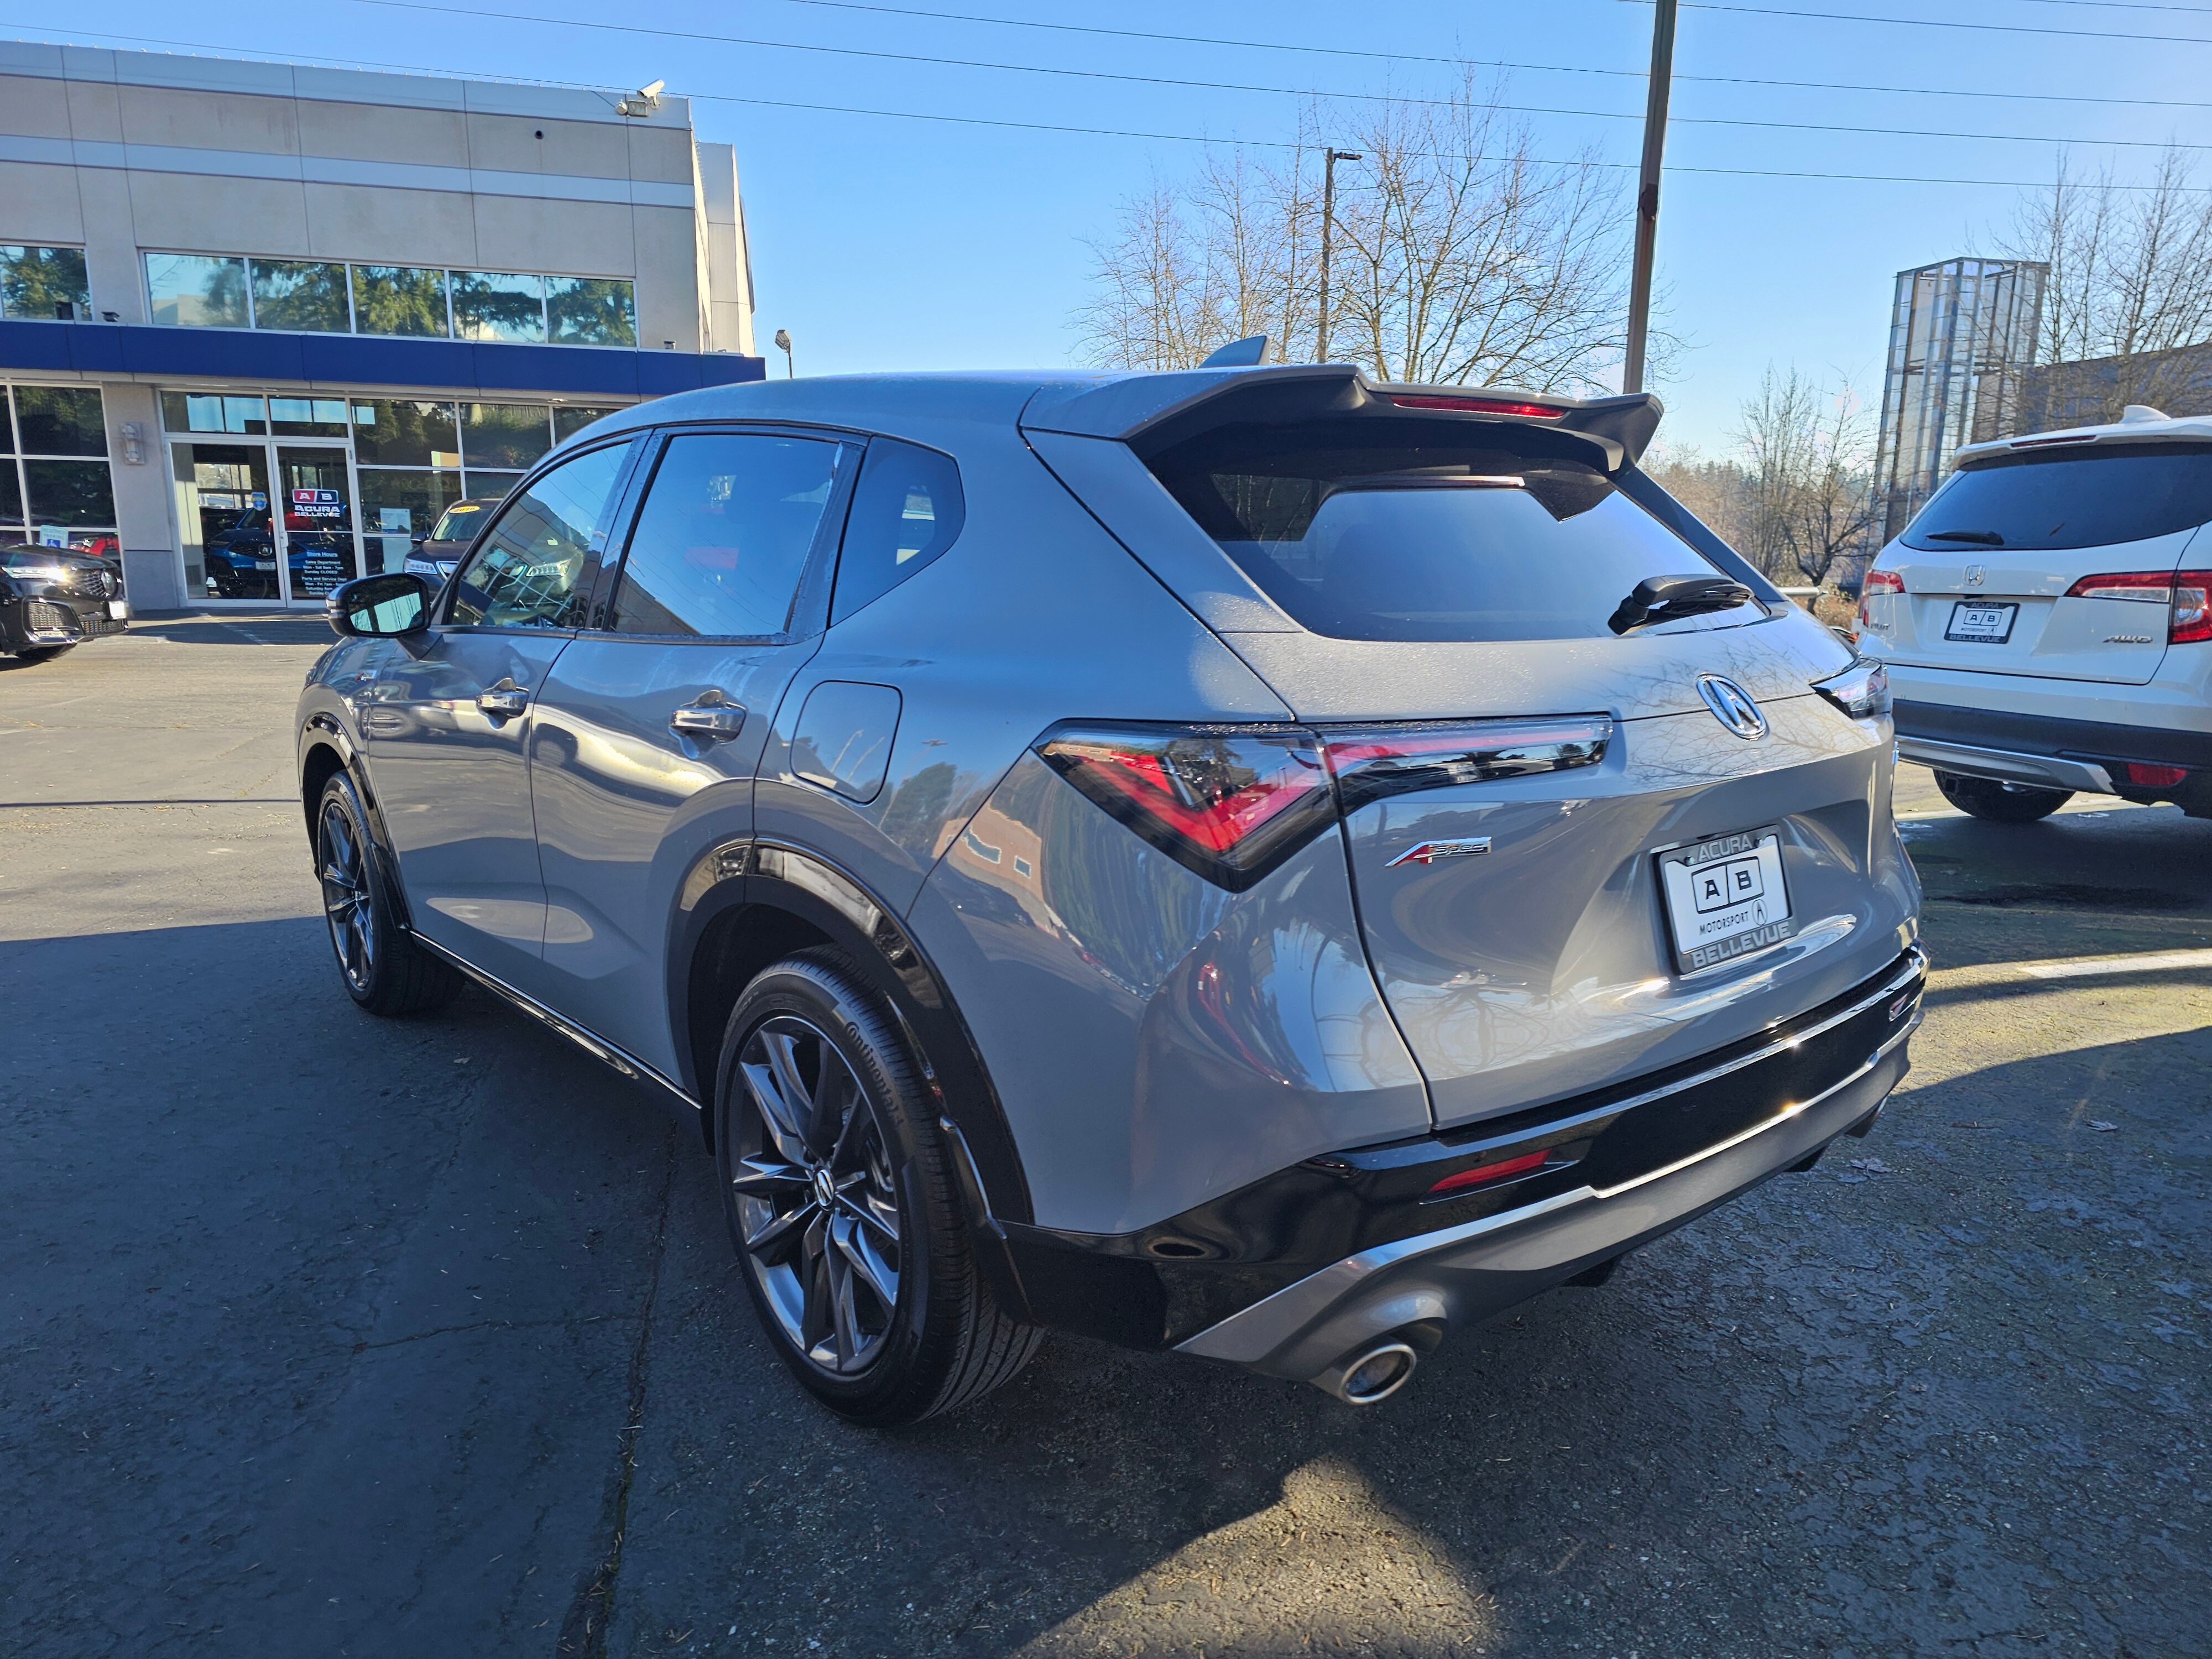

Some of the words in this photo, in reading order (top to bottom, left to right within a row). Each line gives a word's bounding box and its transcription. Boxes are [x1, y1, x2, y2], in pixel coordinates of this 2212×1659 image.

[1949, 634, 2001, 643] BELLEVUE
[1698, 834, 1752, 862] ACURA
[1704, 879, 1720, 900] A
[1735, 870, 1752, 890] B
[1699, 911, 1749, 936] MOTORSPORT
[1691, 921, 1791, 968] BELLEVUE
[844, 1021, 899, 1114] Continental
